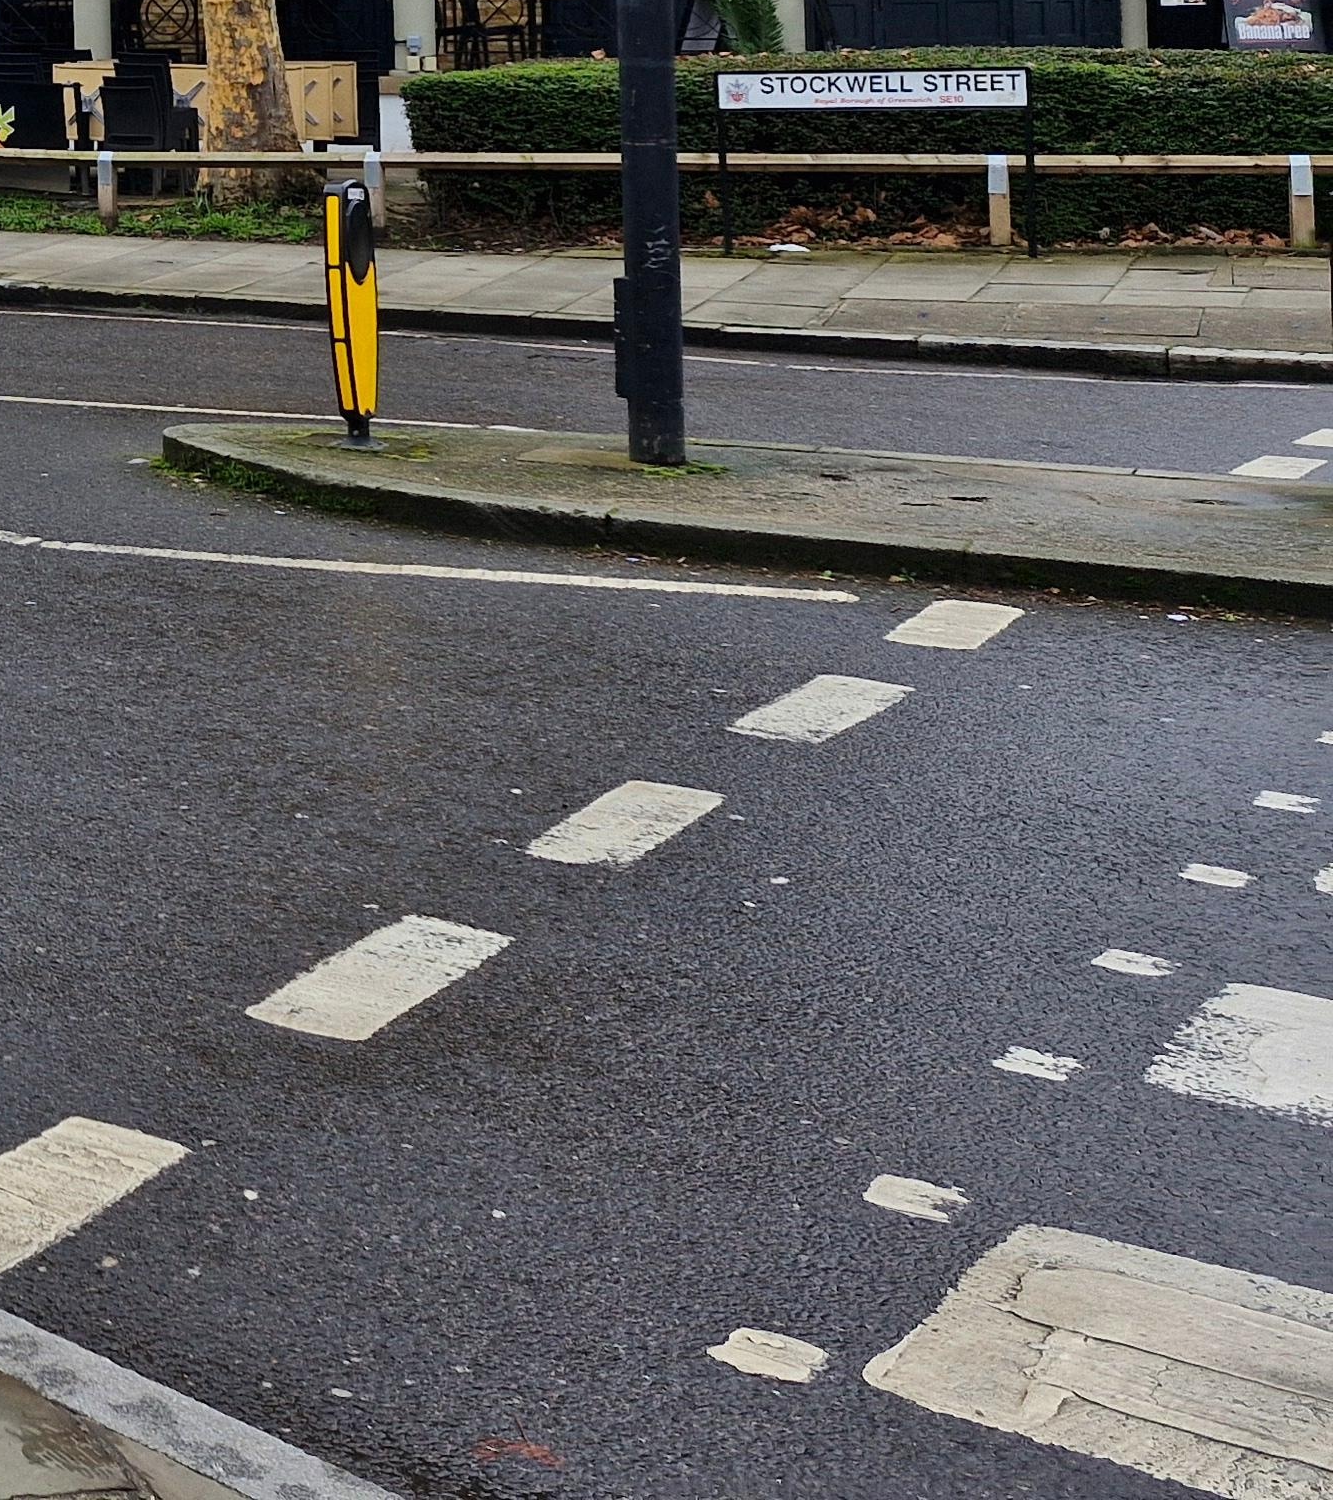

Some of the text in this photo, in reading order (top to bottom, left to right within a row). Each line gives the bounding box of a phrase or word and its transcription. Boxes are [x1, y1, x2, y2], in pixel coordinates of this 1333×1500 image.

[760, 73, 1021, 95] STOCKWELL STREET
[939, 95, 964, 104] SE10
